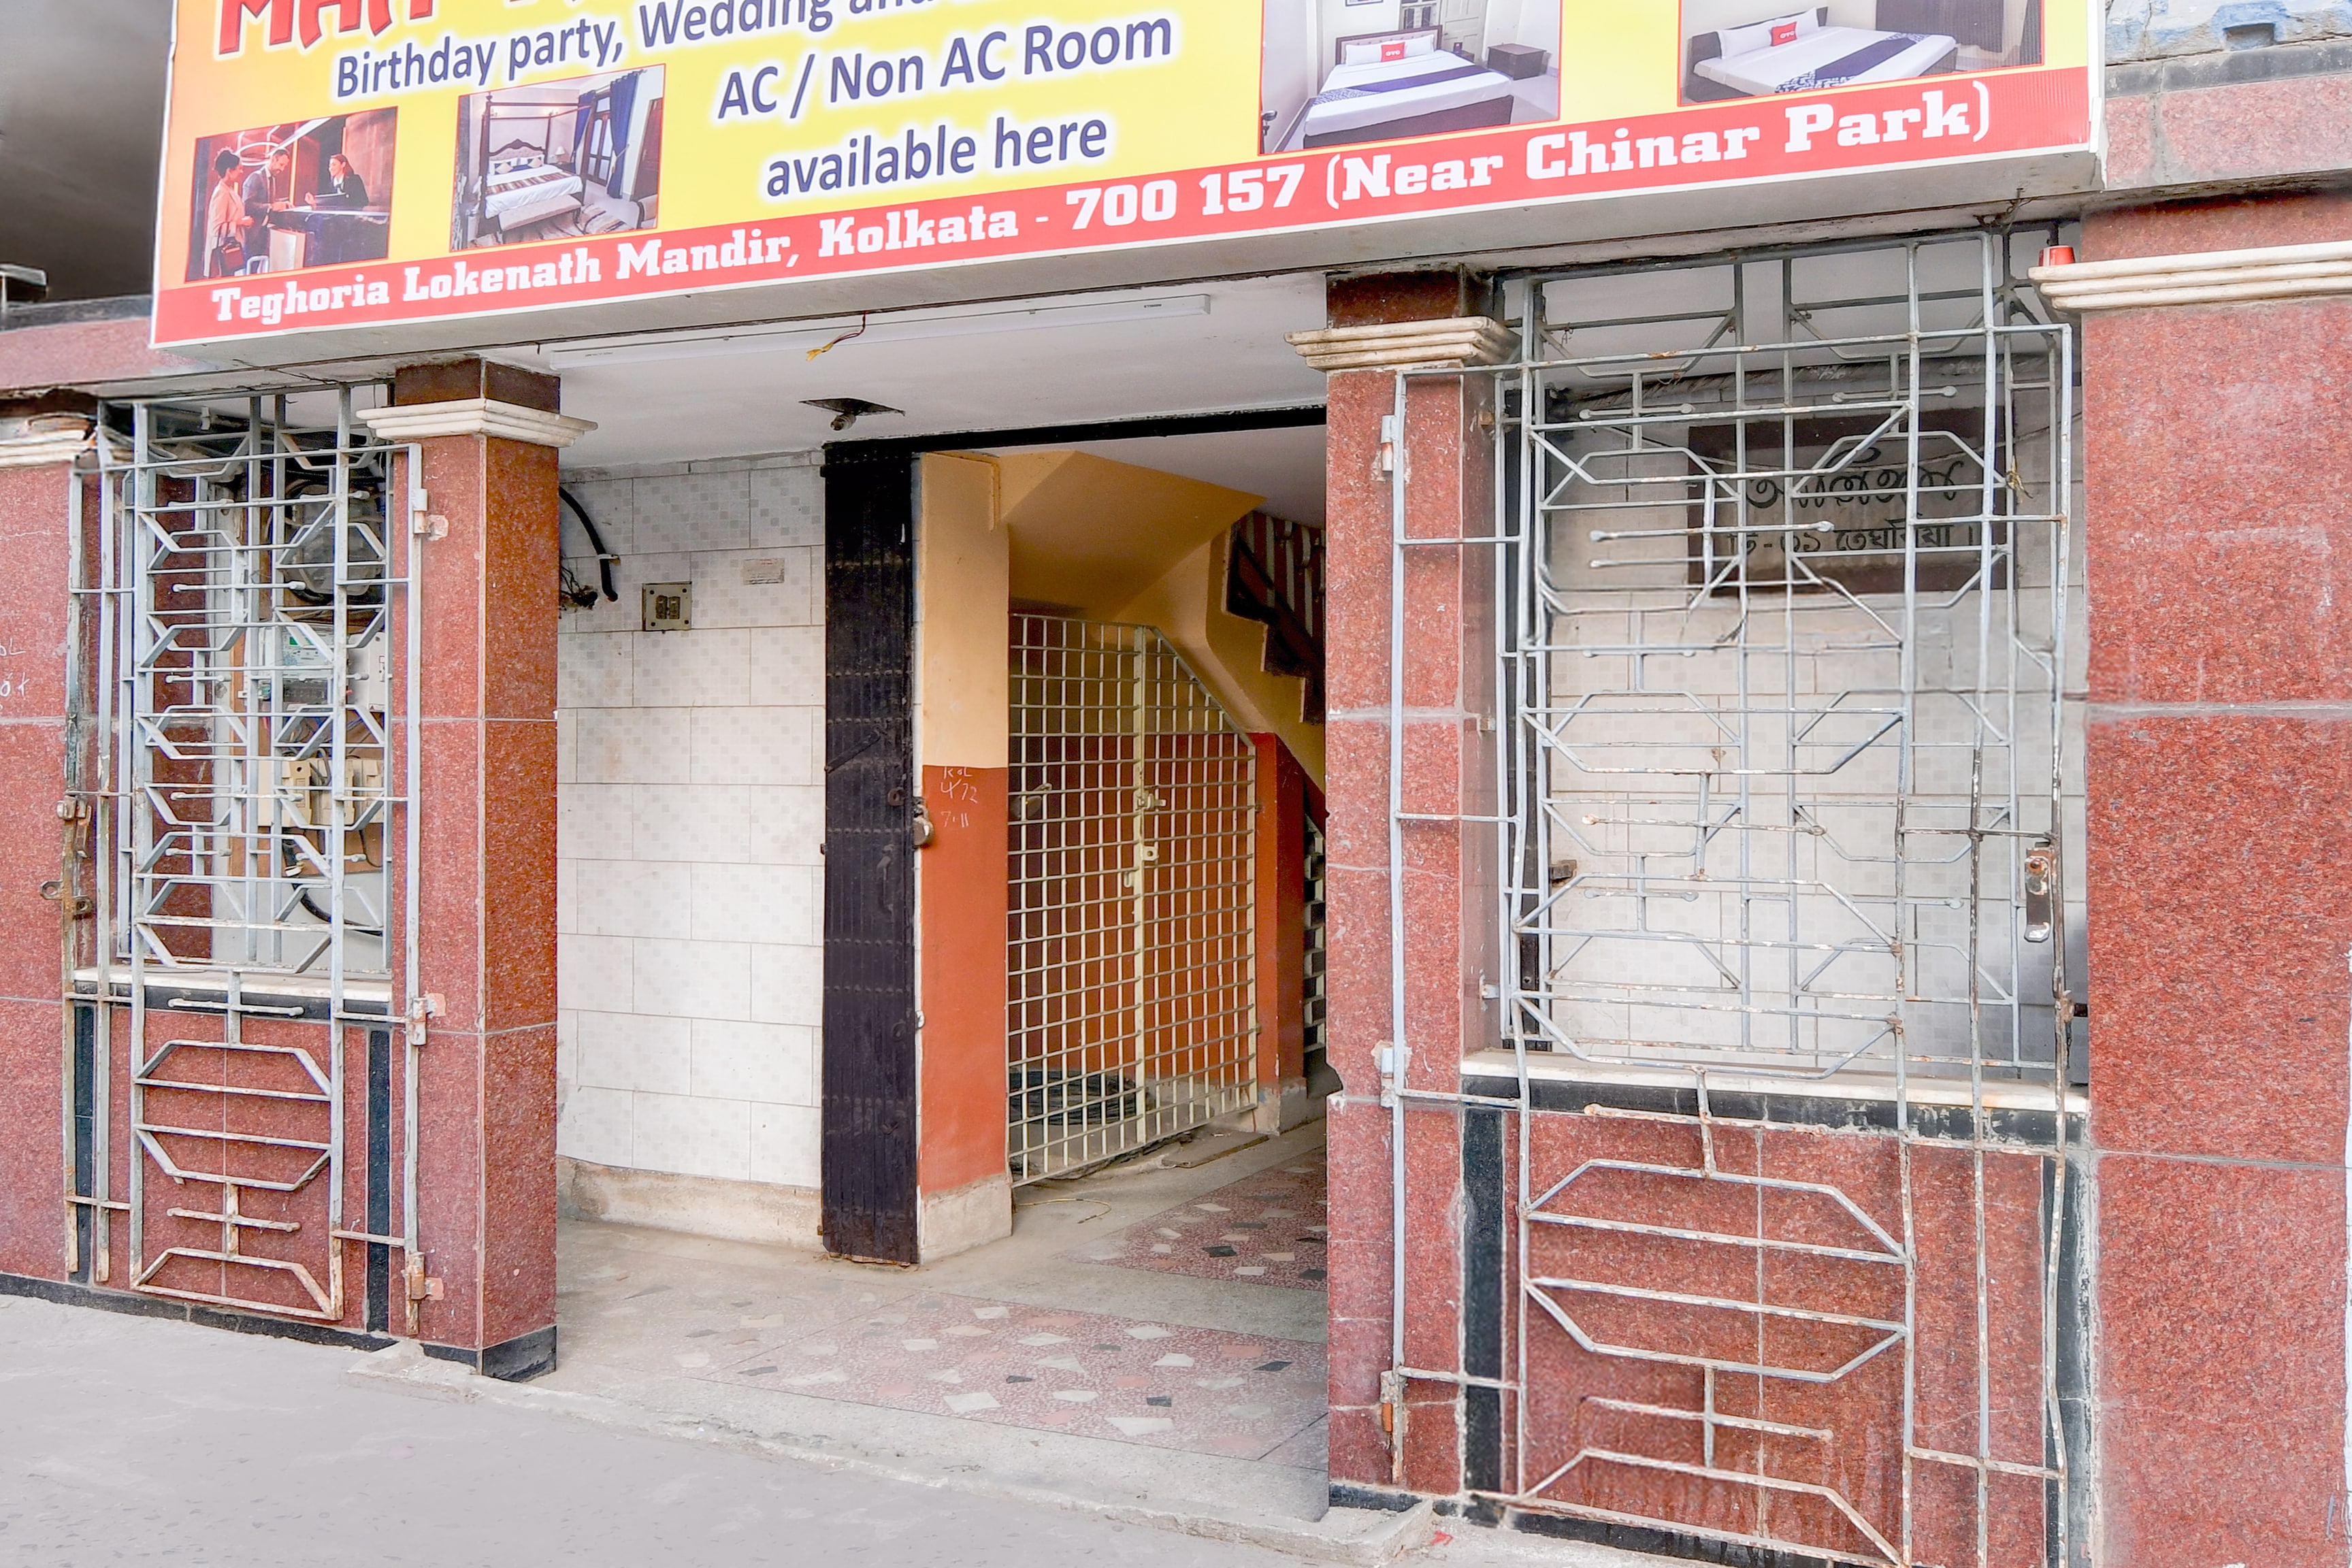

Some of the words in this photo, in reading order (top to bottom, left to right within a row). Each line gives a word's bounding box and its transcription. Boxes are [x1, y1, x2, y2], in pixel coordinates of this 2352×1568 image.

[339, 36, 496, 97] Birthday
[510, 18, 623, 80] party,
[638, 0, 833, 48] Wedding
[718, 67, 778, 118] AC
[831, 54, 924, 103] Non
[941, 32, 1007, 87] AC
[1025, 18, 1171, 74] Room
[212, 281, 390, 325] Teghoria
[403, 246, 601, 301] Lokenath
[617, 229, 799, 279] Mandir,
[818, 208, 1019, 257] Kolkata
[1064, 178, 1178, 230] 700
[1198, 163, 1305, 216] 157
[1326, 153, 1504, 211] (Near
[1526, 126, 1761, 181] Chinar
[1785, 80, 1990, 154] Park)
[768, 125, 975, 196] available
[996, 118, 1107, 168] here
